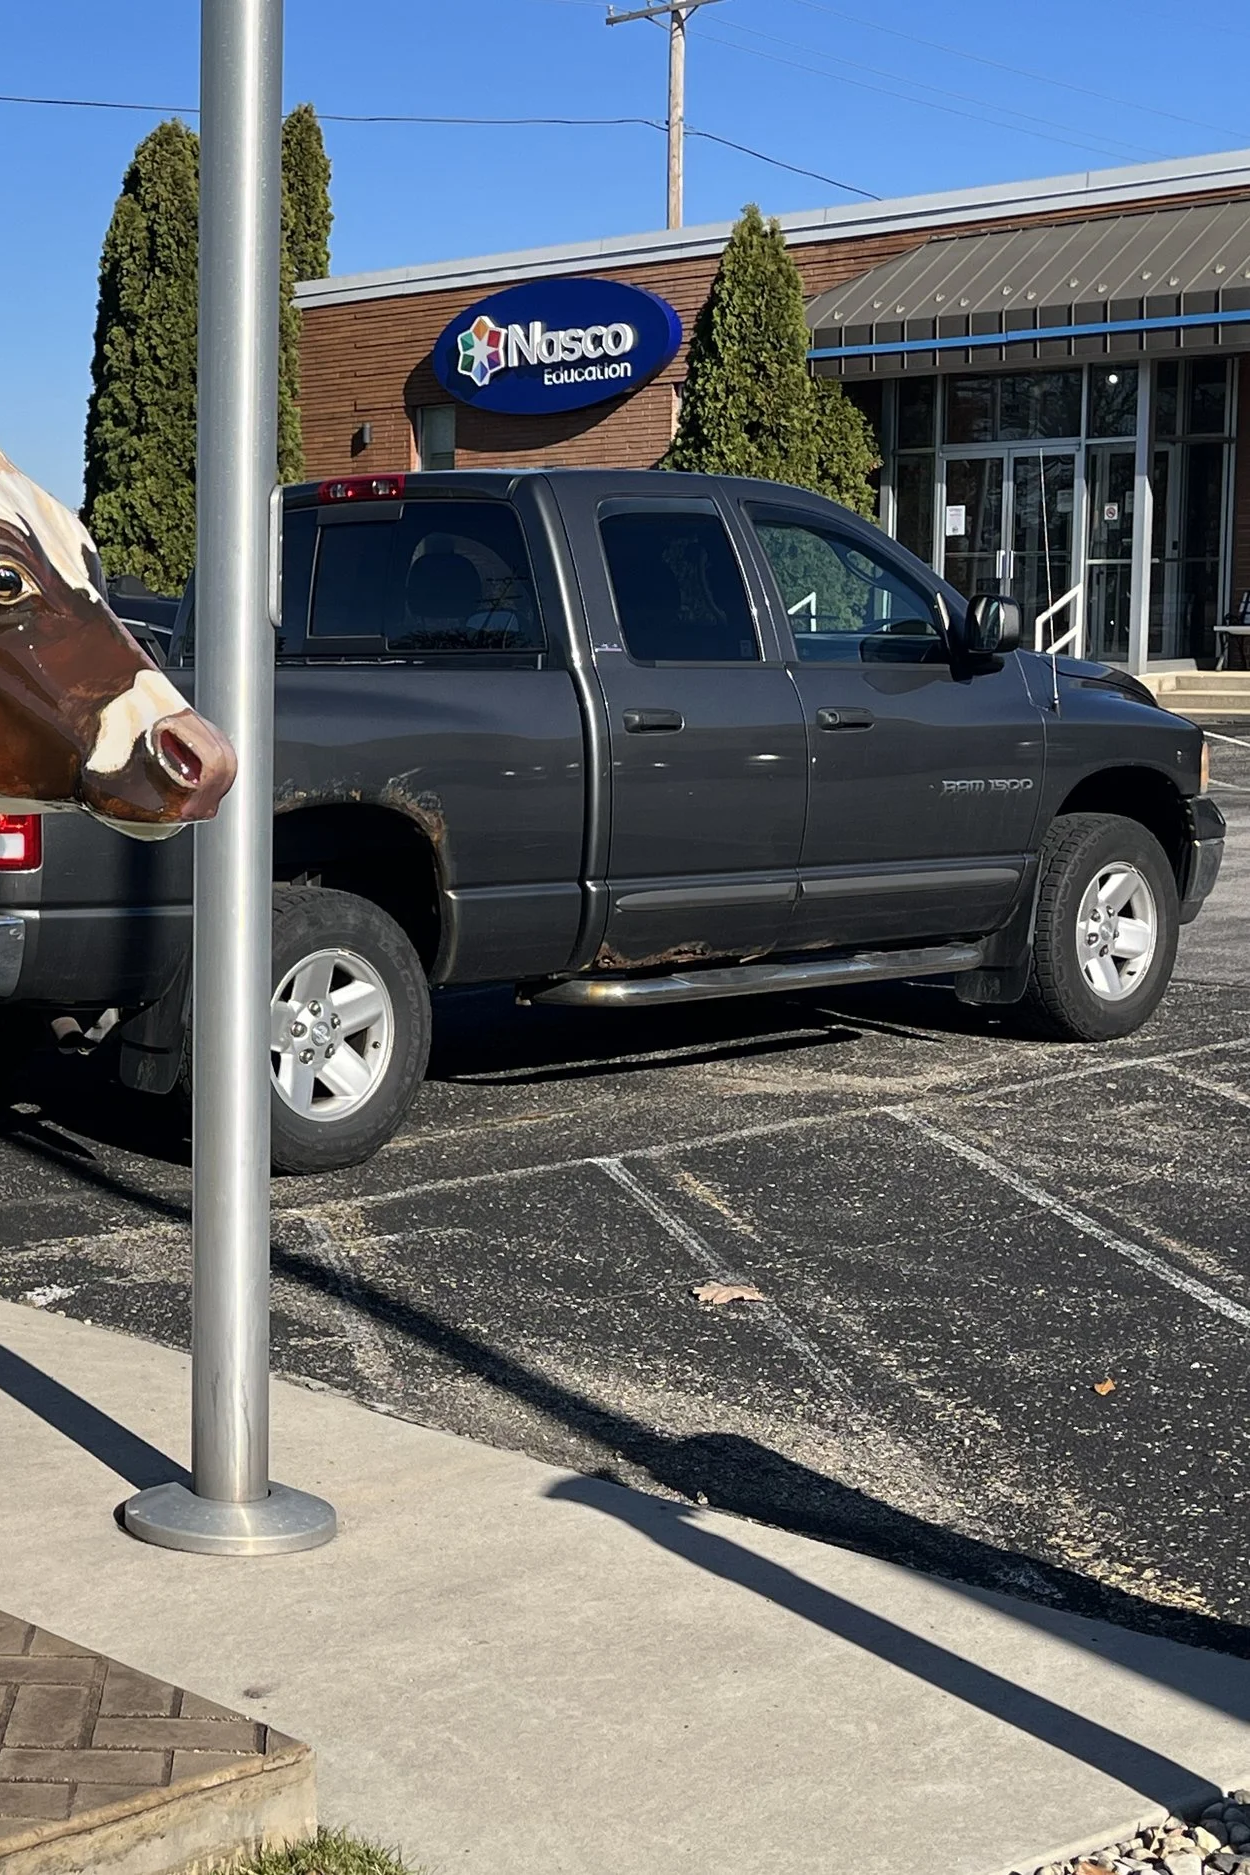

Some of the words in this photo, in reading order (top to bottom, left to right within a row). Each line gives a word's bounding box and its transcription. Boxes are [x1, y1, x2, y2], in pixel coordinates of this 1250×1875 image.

[507, 321, 634, 367] Nasco
[543, 361, 632, 386] Education
[942, 780, 985, 792] RAM
[988, 778, 1034, 791] 1500
